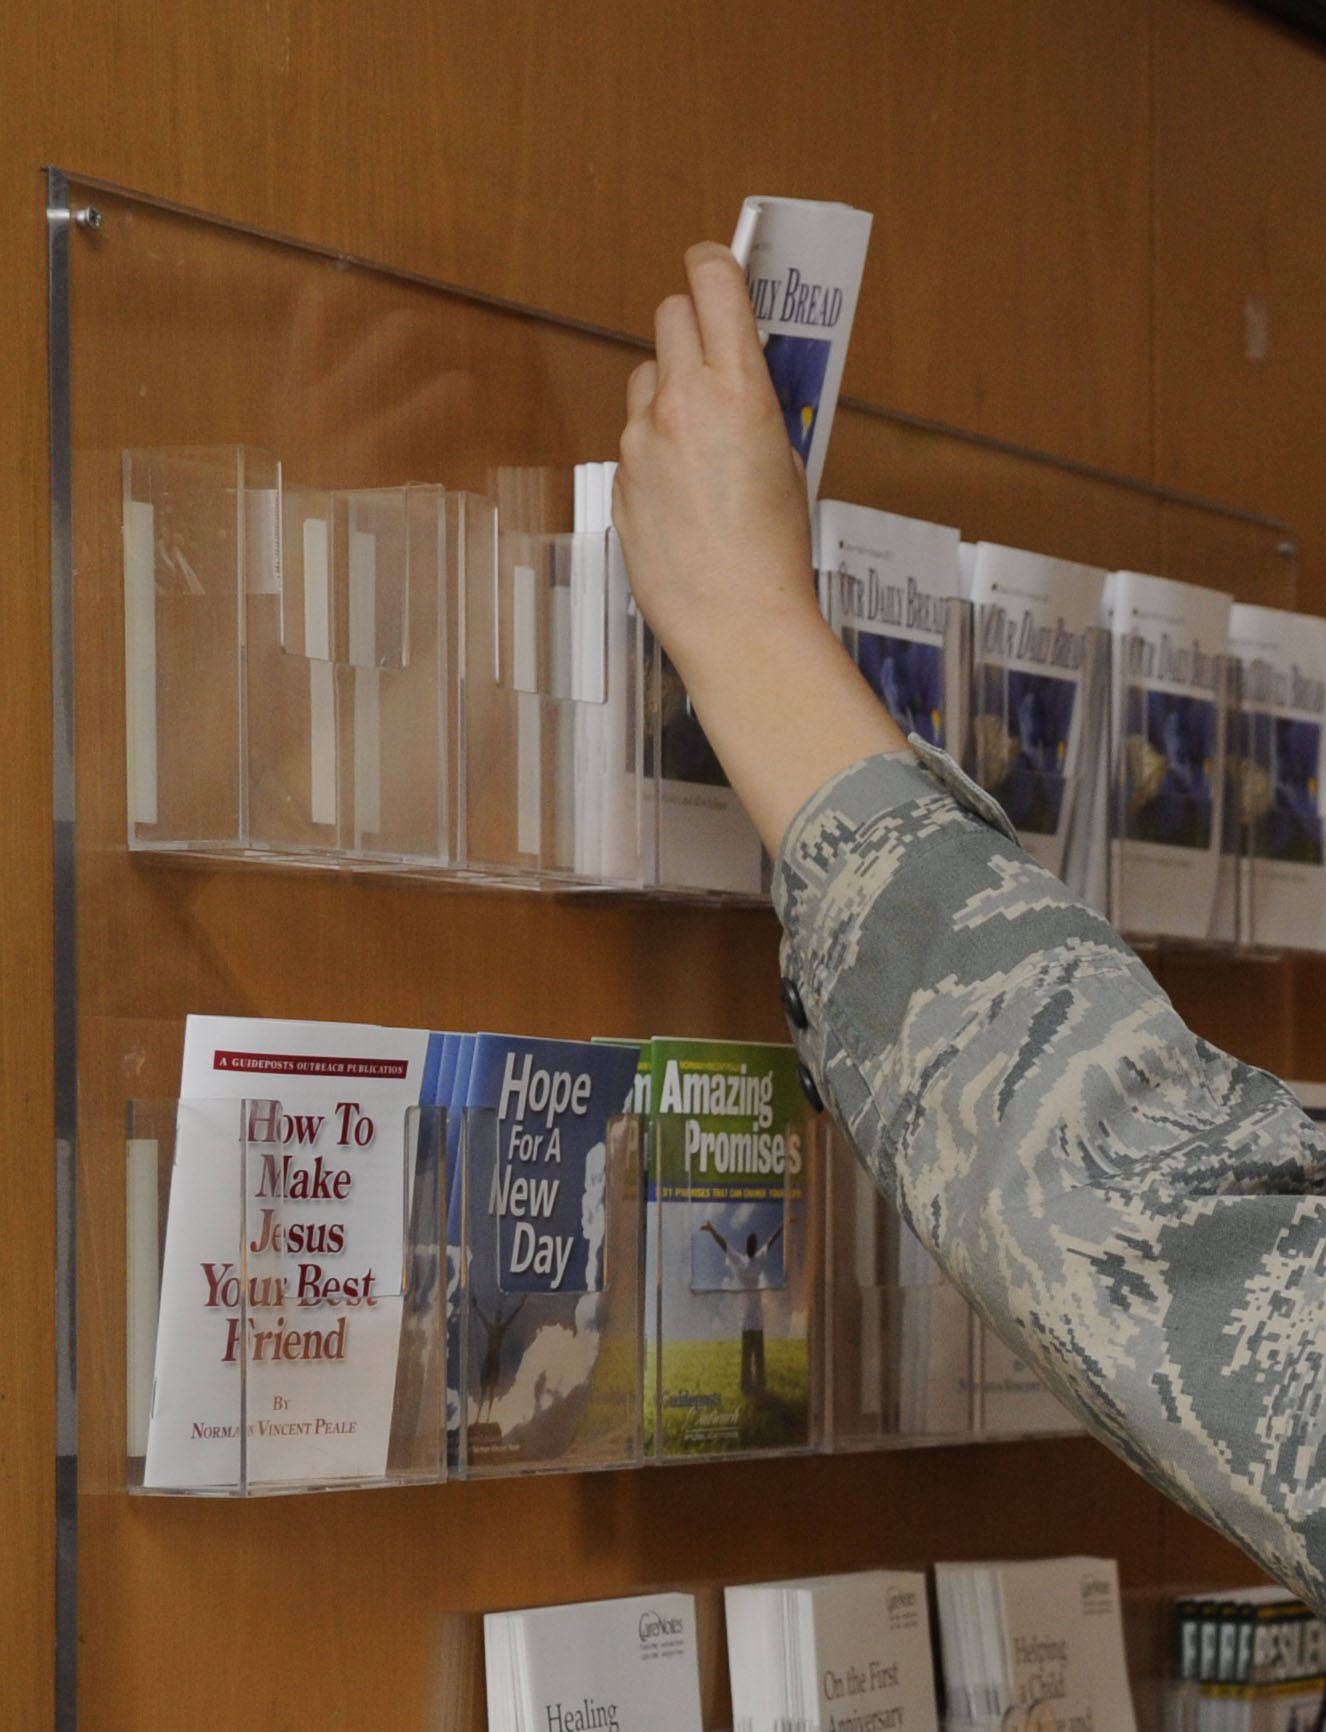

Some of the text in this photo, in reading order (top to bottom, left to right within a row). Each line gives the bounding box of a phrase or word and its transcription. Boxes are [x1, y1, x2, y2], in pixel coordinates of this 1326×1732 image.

[780, 266, 843, 328] BREAD
[219, 1057, 404, 1075] A GUIDEPOSTS OUTREACH PUBLICATION
[498, 1051, 592, 1129] Hope
[659, 1059, 774, 1129] Amazing
[244, 1100, 375, 1147] How To
[507, 1123, 562, 1164] For A
[684, 1118, 801, 1174] Promises
[254, 1153, 352, 1201] Make
[487, 1163, 560, 1219] New
[249, 1208, 345, 1254] Jesus
[509, 1221, 575, 1290] Day
[200, 1262, 378, 1308] Your Best
[221, 1316, 346, 1363] Friend
[256, 1419, 314, 1438] VINCENT
[313, 1417, 358, 1436] PEALE
[823, 1660, 900, 1700] On the First
